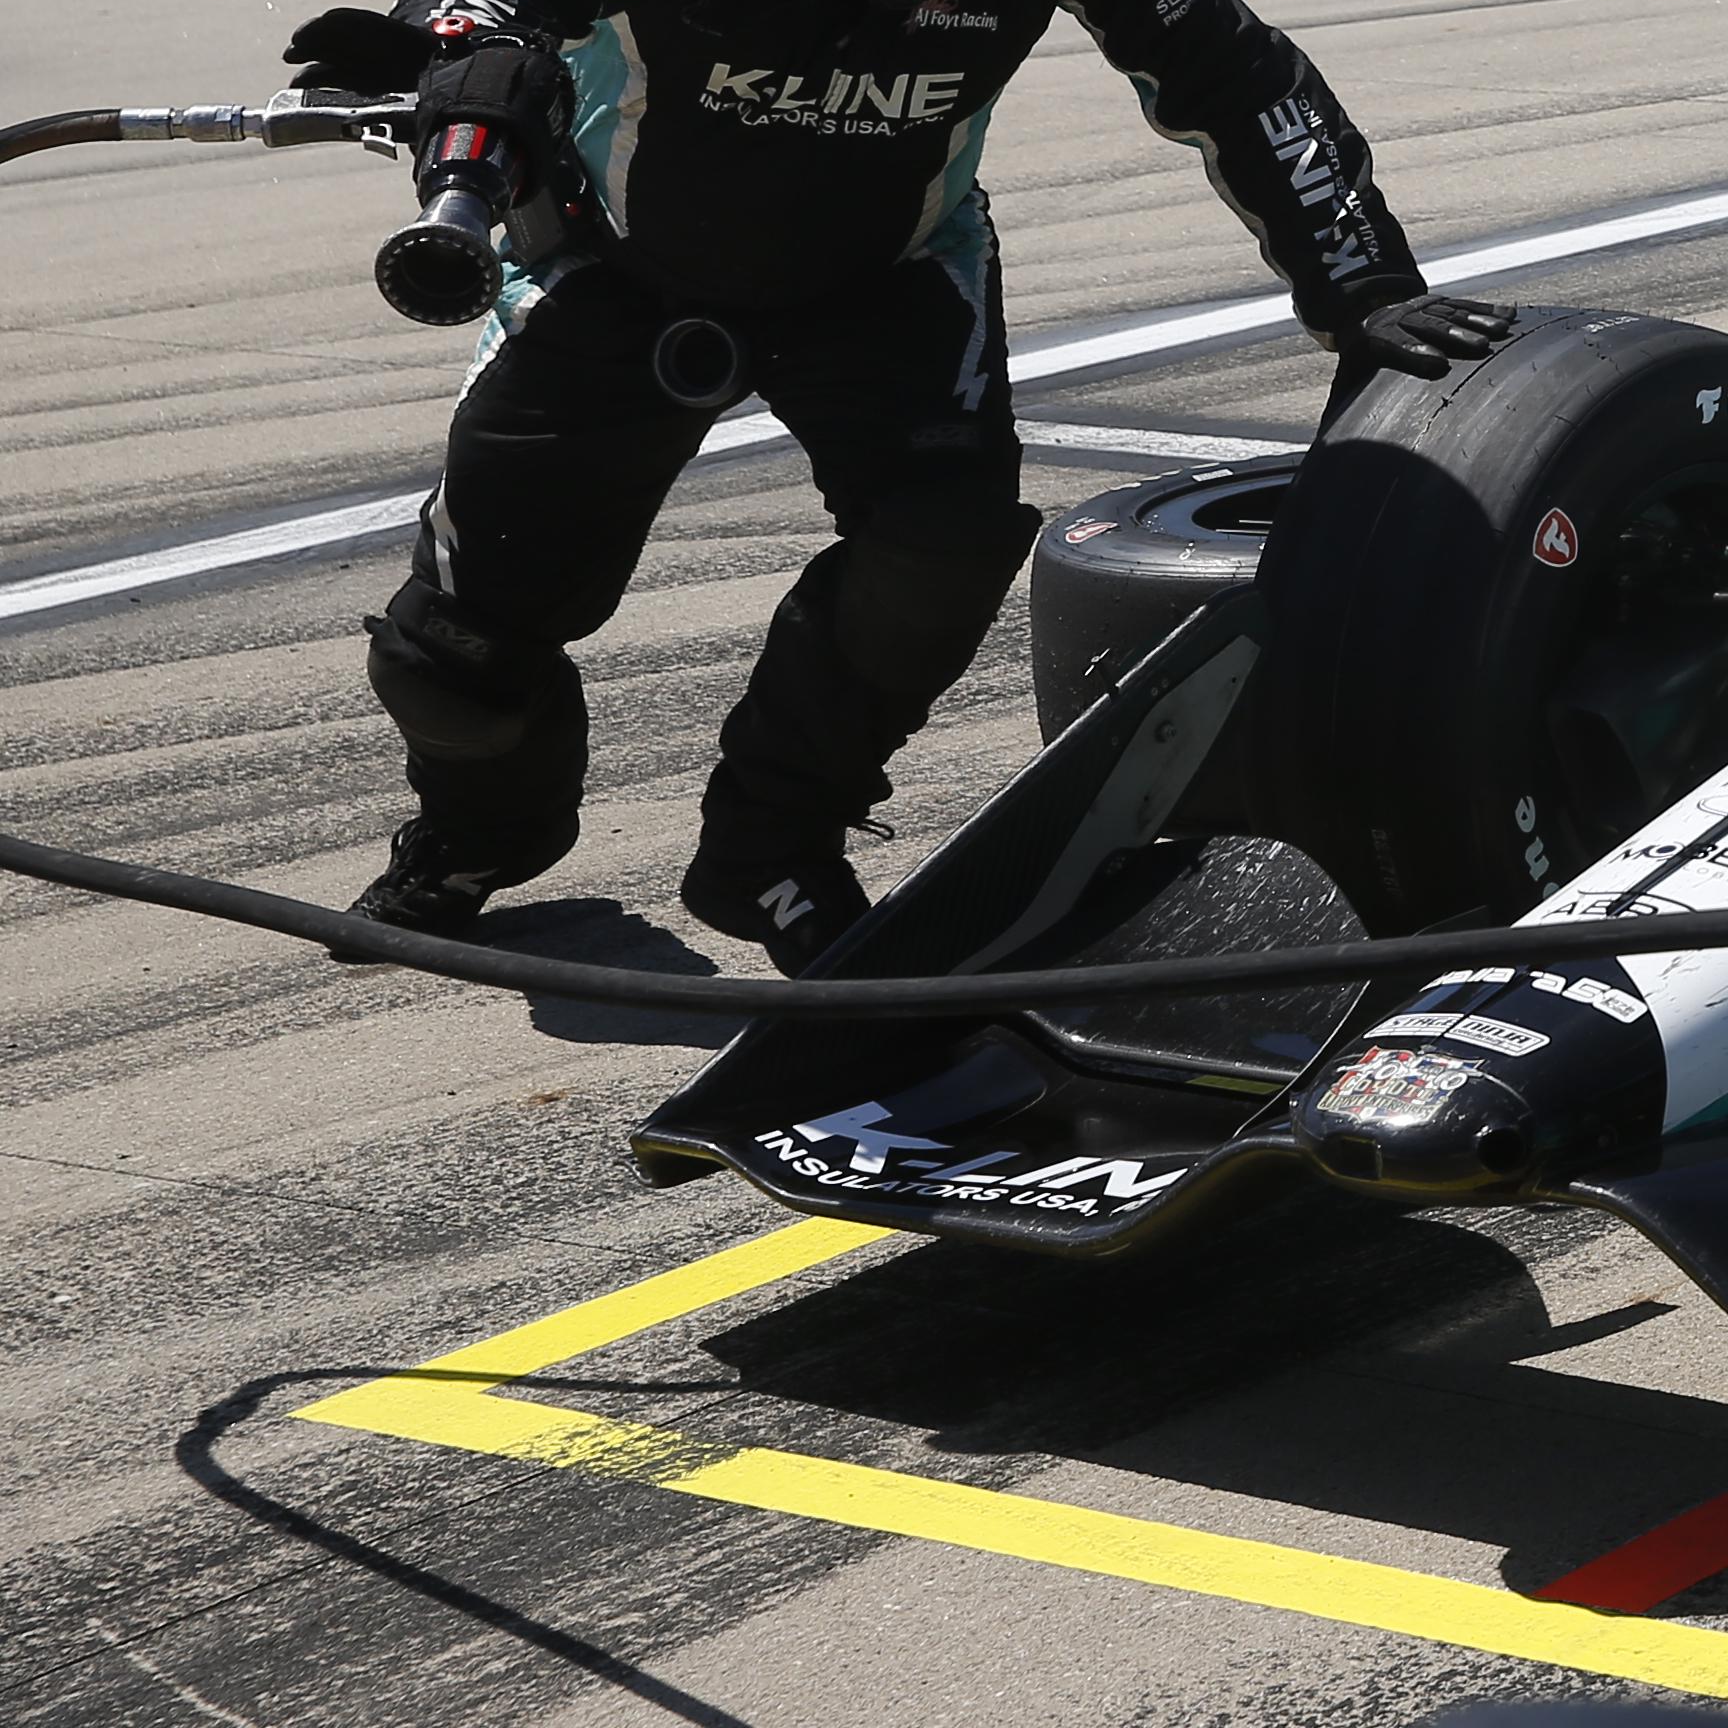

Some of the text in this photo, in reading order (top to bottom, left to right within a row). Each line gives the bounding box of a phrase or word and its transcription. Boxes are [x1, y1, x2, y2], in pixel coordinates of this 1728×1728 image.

[914, 7, 999, 31] AJ Foyt Racing
[1257, 97, 1370, 282] K-LINE
[756, 878, 816, 930] N
[1461, 1018, 1535, 1049] NINJA
[754, 1128, 1099, 1219] INSULATORS USA,
